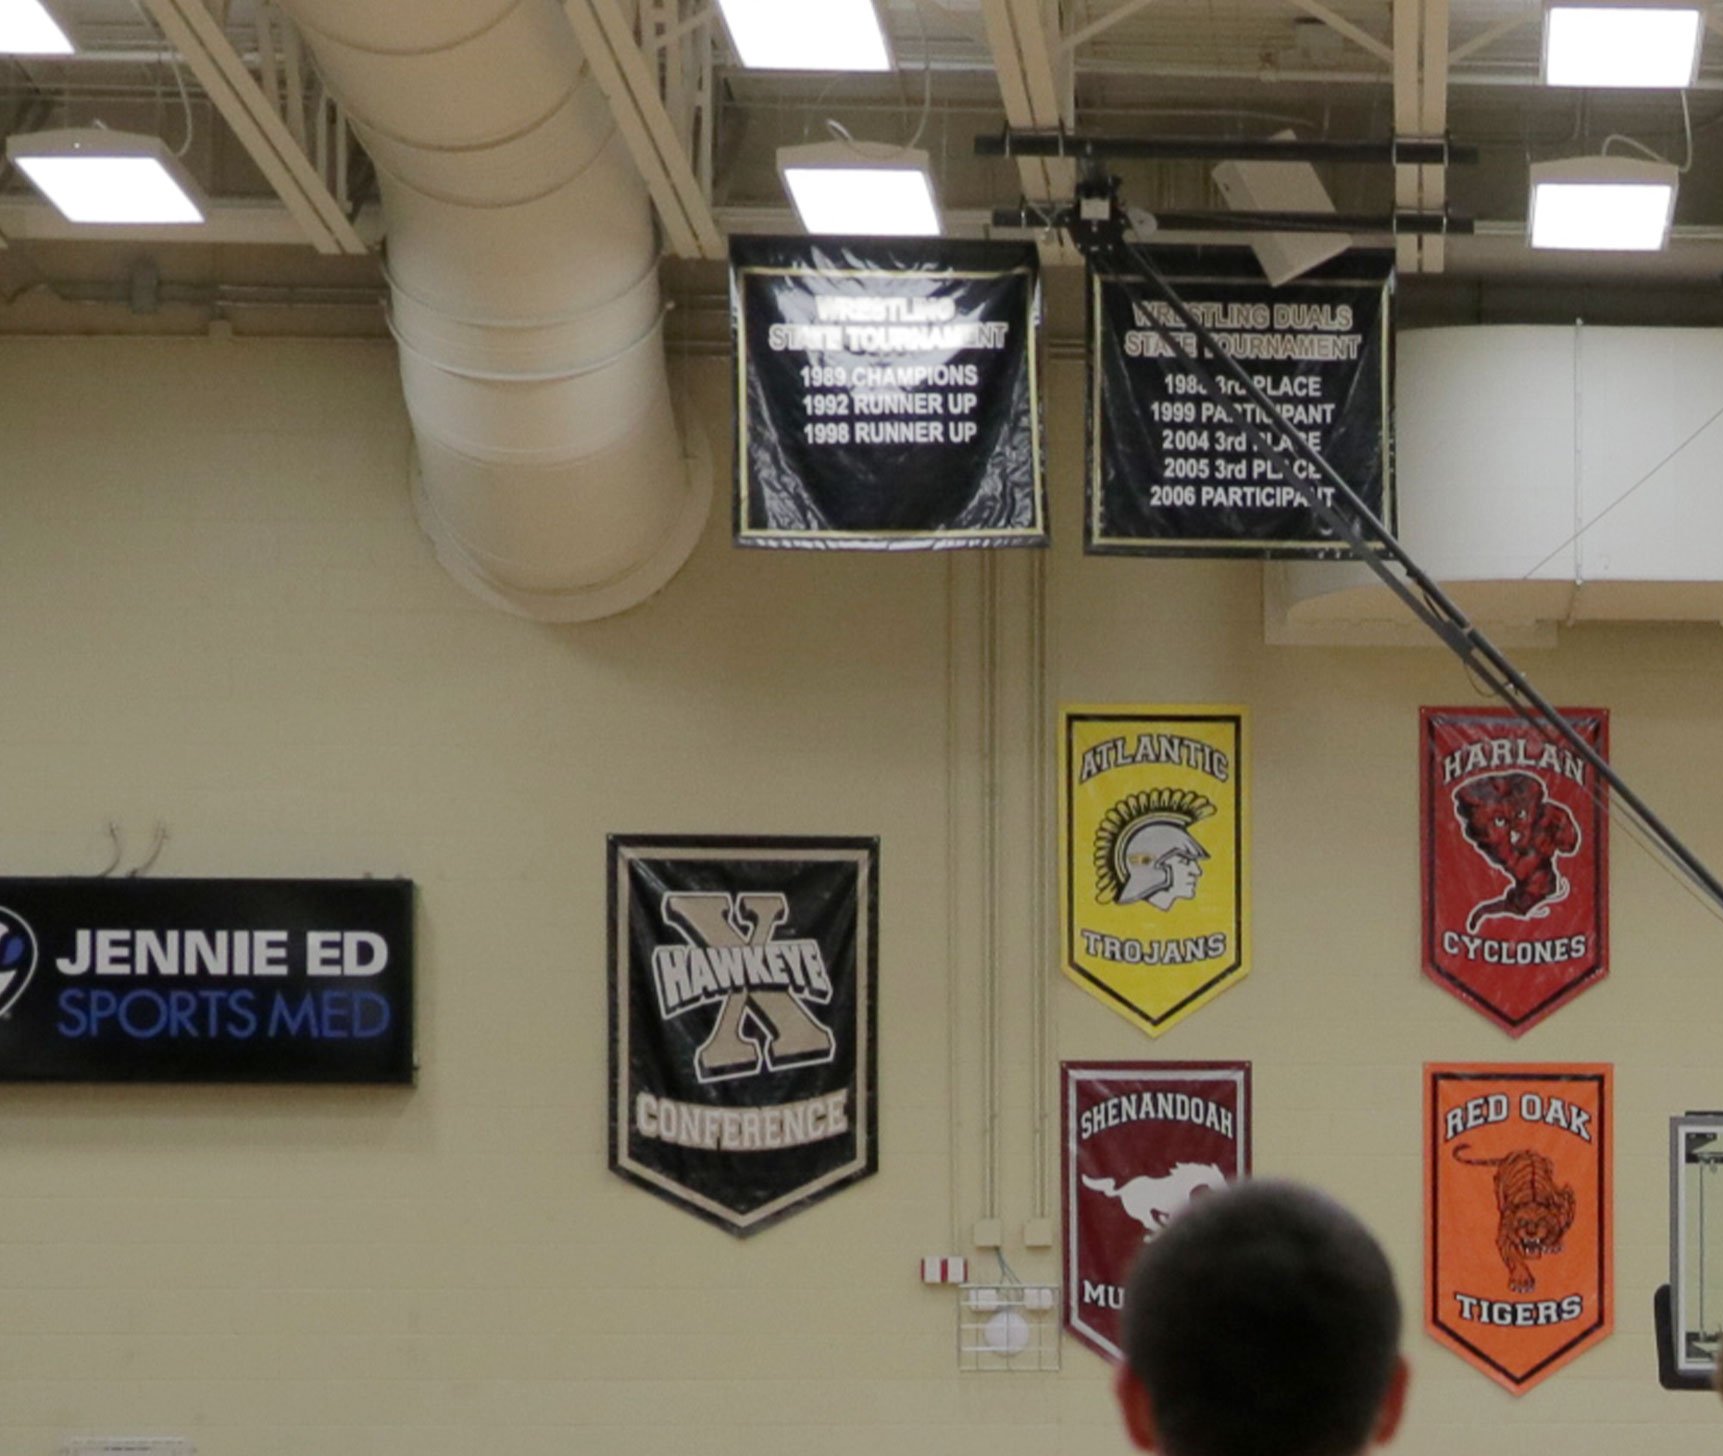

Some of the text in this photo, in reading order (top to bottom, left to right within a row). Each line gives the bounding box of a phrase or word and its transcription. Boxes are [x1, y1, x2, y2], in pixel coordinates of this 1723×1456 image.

[801, 365, 978, 385] 1989 CHAMPIONS
[803, 393, 977, 414] 1992 RUNNER UP
[1150, 402, 1196, 423] 1999
[803, 422, 977, 444] 1998 RUNNER UP
[1162, 429, 1247, 451] 2004 3rd
[1163, 458, 1247, 479] 2005 3rd
[1150, 485, 1196, 506] 2006
[1080, 733, 1228, 784] ATLANTIC
[1444, 737, 1586, 786] HARLAN
[56, 929, 388, 976] JENNIE ED
[1082, 931, 1226, 965] TROJANS
[1444, 931, 1586, 965] CYCLONES
[664, 943, 824, 1001] HAWKEYE
[58, 990, 390, 1039] SPORTS MED
[636, 1090, 849, 1152] CONFERENCE
[1081, 1093, 1233, 1140] SHENANDOAH
[1446, 1093, 1592, 1143] RED OAK
[1455, 1294, 1583, 1327] TIGERS
